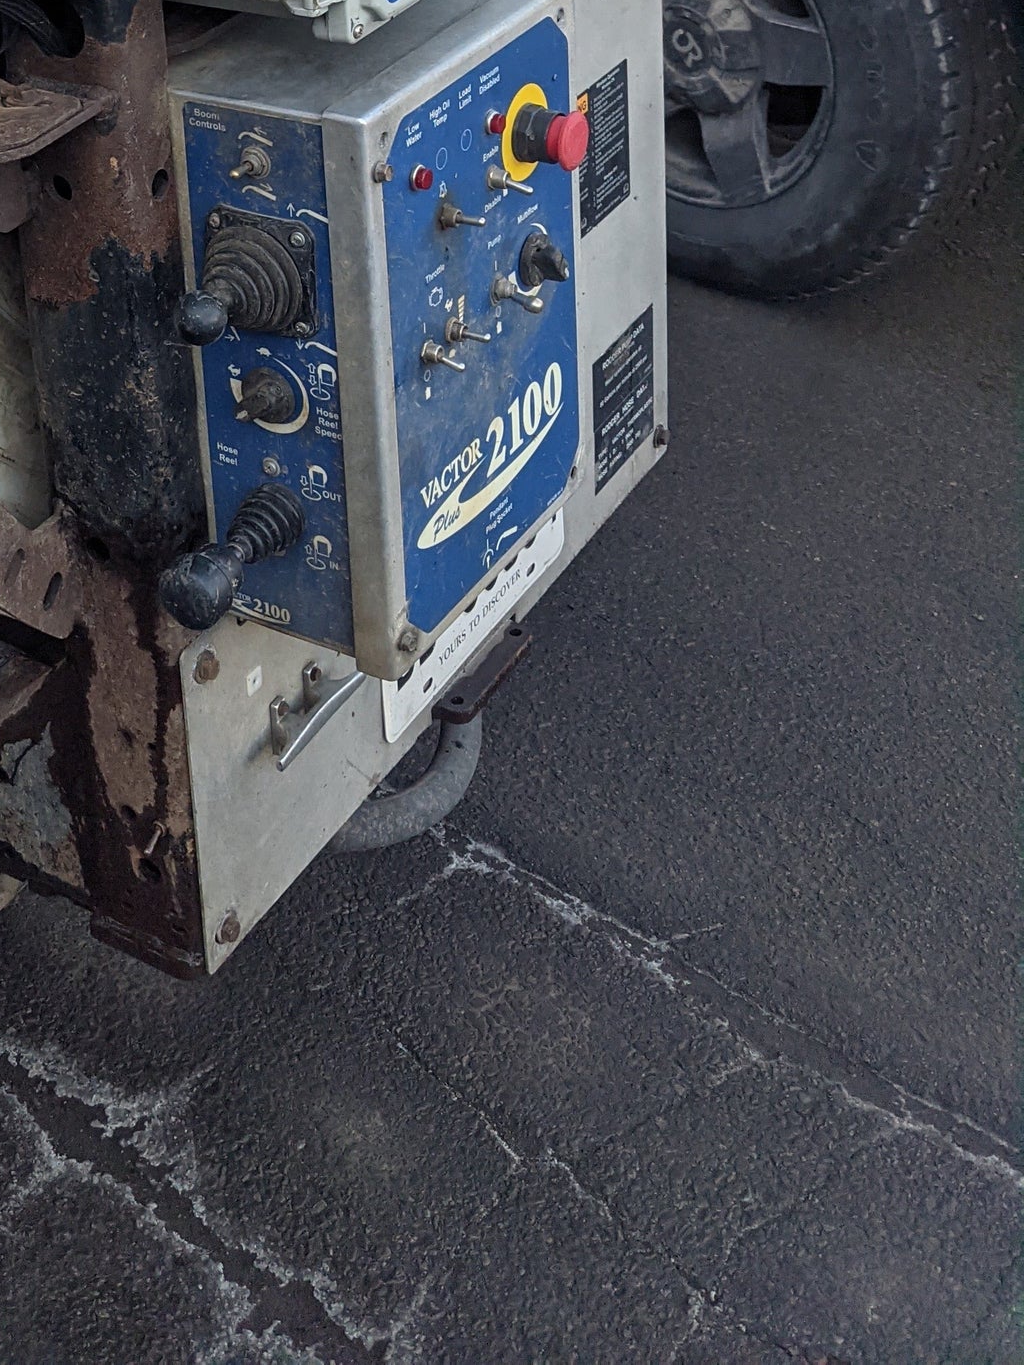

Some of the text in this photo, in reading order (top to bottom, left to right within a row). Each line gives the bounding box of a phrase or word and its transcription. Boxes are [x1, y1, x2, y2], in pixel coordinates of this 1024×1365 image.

[480, 66, 499, 83] Vacuum
[459, 84, 471, 99] Load
[479, 76, 500, 95] Disabled
[429, 99, 450, 120] High Oil
[459, 96, 472, 110] Limit
[189, 117, 226, 131] Controls
[408, 122, 419, 135] Low
[433, 115, 447, 128] Temp
[406, 132, 422, 147] Water
[483, 145, 499, 163] Enable
[488, 234, 501, 249] Pump
[426, 264, 445, 283] Throttle
[316, 407, 339, 420] Hose
[318, 418, 338, 429] Reel
[420, 437, 483, 509] VACTOR
[485, 362, 562, 478] 2100
[217, 442, 238, 455] Hose
[219, 453, 238, 465] Reel
[323, 490, 342, 502] OUT
[490, 497, 508, 520] Pendant
[433, 506, 461, 541] Plus
[329, 561, 339, 571] IN
[253, 599, 290, 622] 2100
[438, 568, 521, 665] YOURS TO DISCOVER
